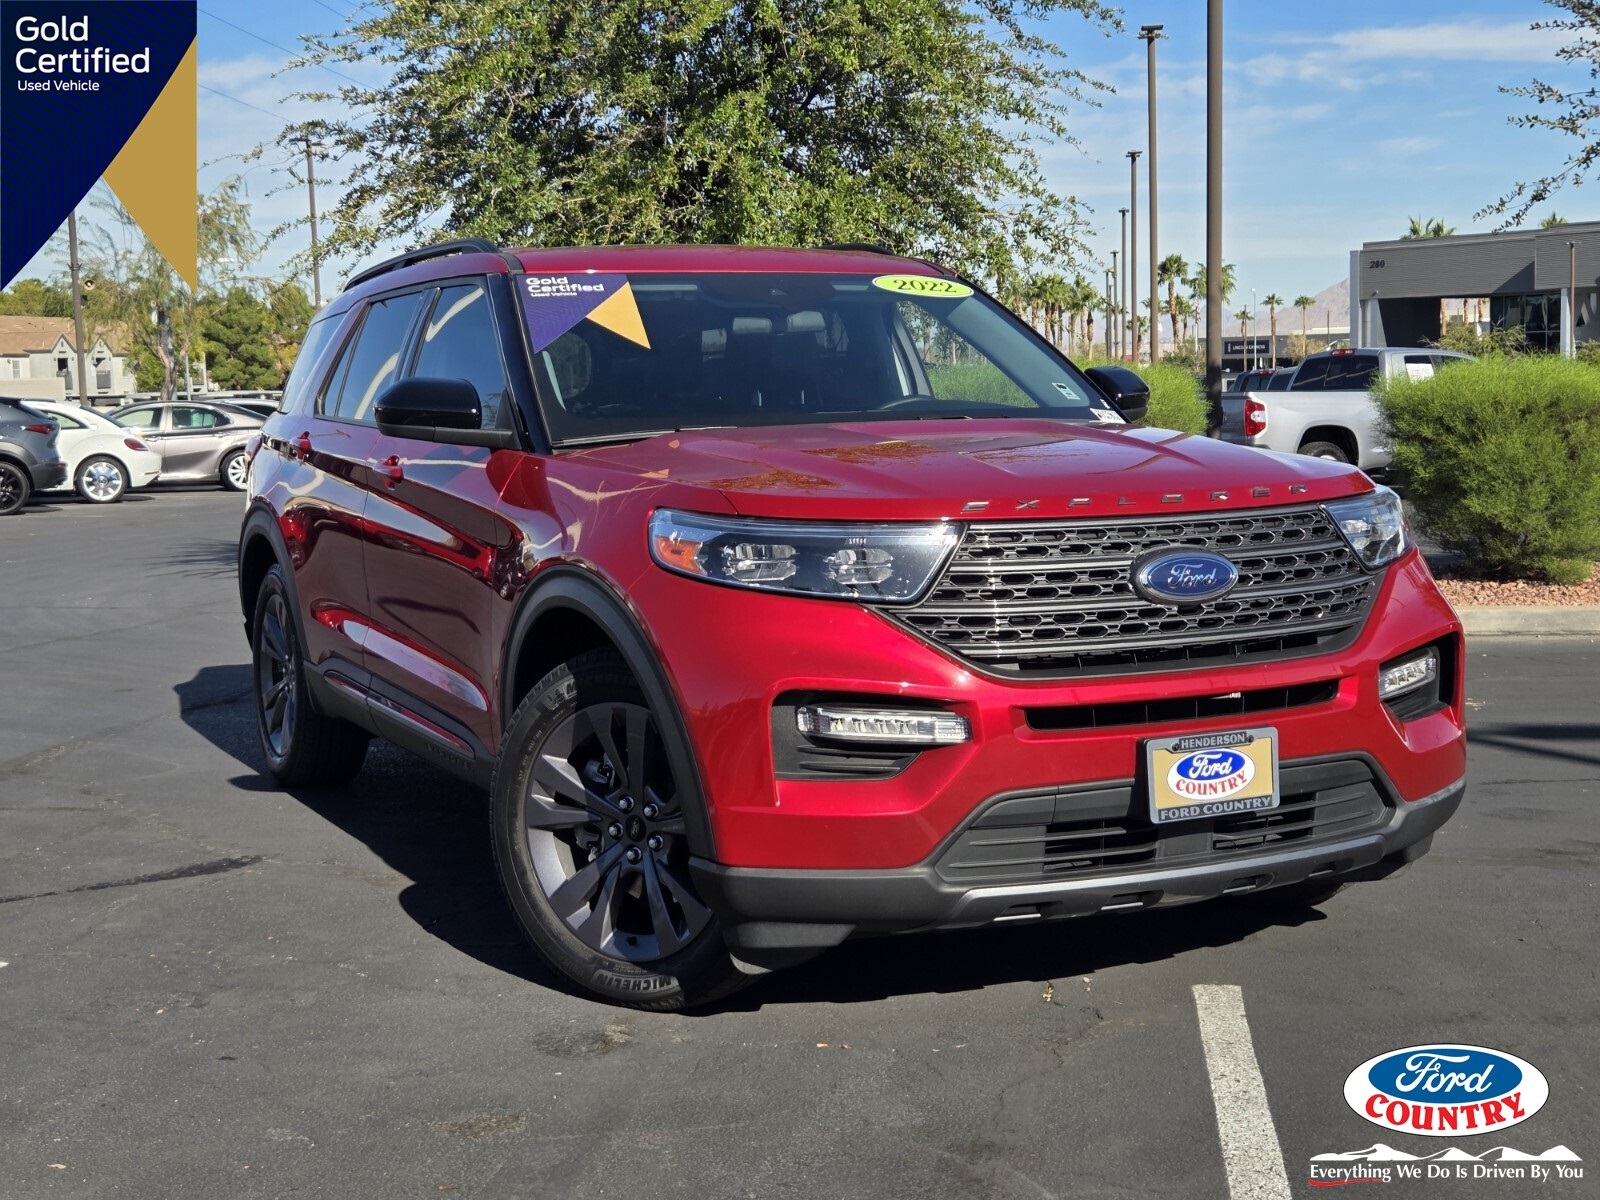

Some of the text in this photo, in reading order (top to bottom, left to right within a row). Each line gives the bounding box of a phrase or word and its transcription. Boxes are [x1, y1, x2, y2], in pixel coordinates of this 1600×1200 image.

[1369, 260, 1386, 269] 280
[526, 276, 569, 285] Gold
[527, 283, 605, 293] Certified
[893, 279, 957, 293] 2022
[961, 484, 1308, 513] EXPLORER
[1167, 563, 1217, 589] Ford
[1181, 733, 1246, 749] HENDERSON
[1188, 753, 1234, 779] Ford
[1175, 769, 1248, 796] COUNTRY
[1160, 796, 1272, 820] FORD COUNTRY
[597, 973, 672, 991] MICHELIN
